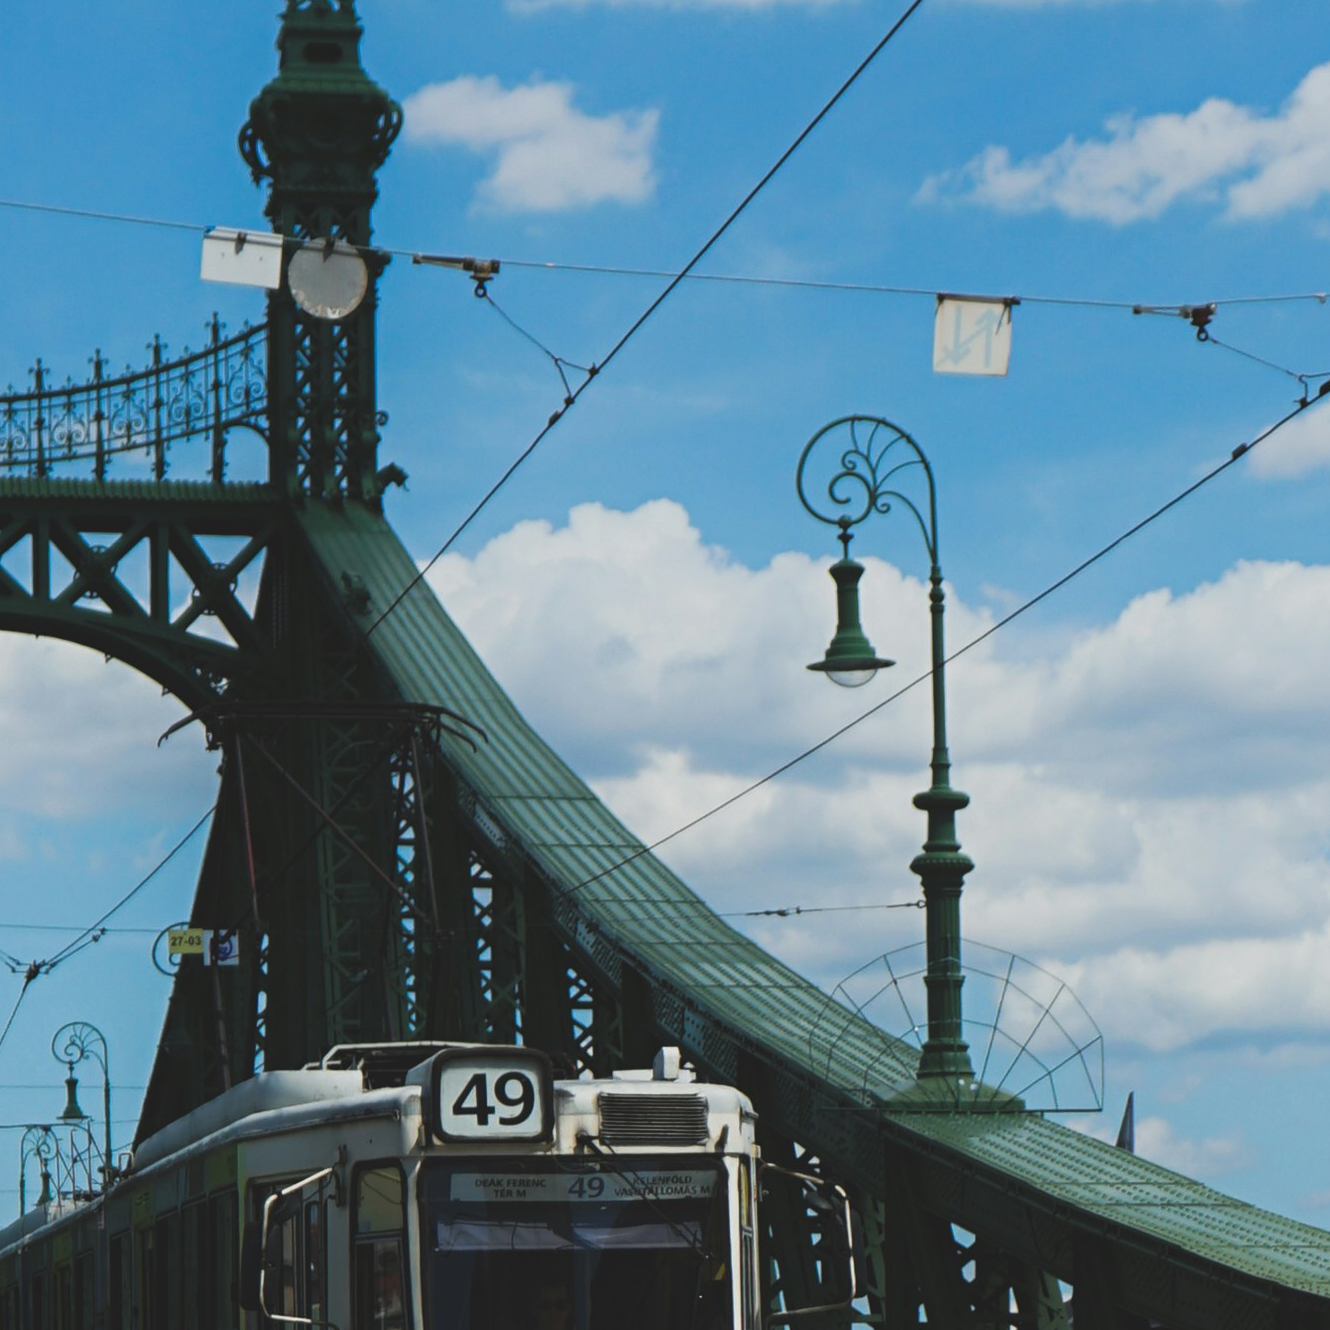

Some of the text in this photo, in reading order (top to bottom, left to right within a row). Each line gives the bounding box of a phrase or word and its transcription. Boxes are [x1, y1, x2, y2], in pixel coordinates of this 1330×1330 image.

[171, 935, 201, 947] 27-03
[453, 1071, 535, 1126] 49
[506, 1178, 547, 1188] FERENC
[567, 1176, 606, 1198] 49
[516, 1189, 527, 1198] M
[700, 1186, 711, 1196] M
